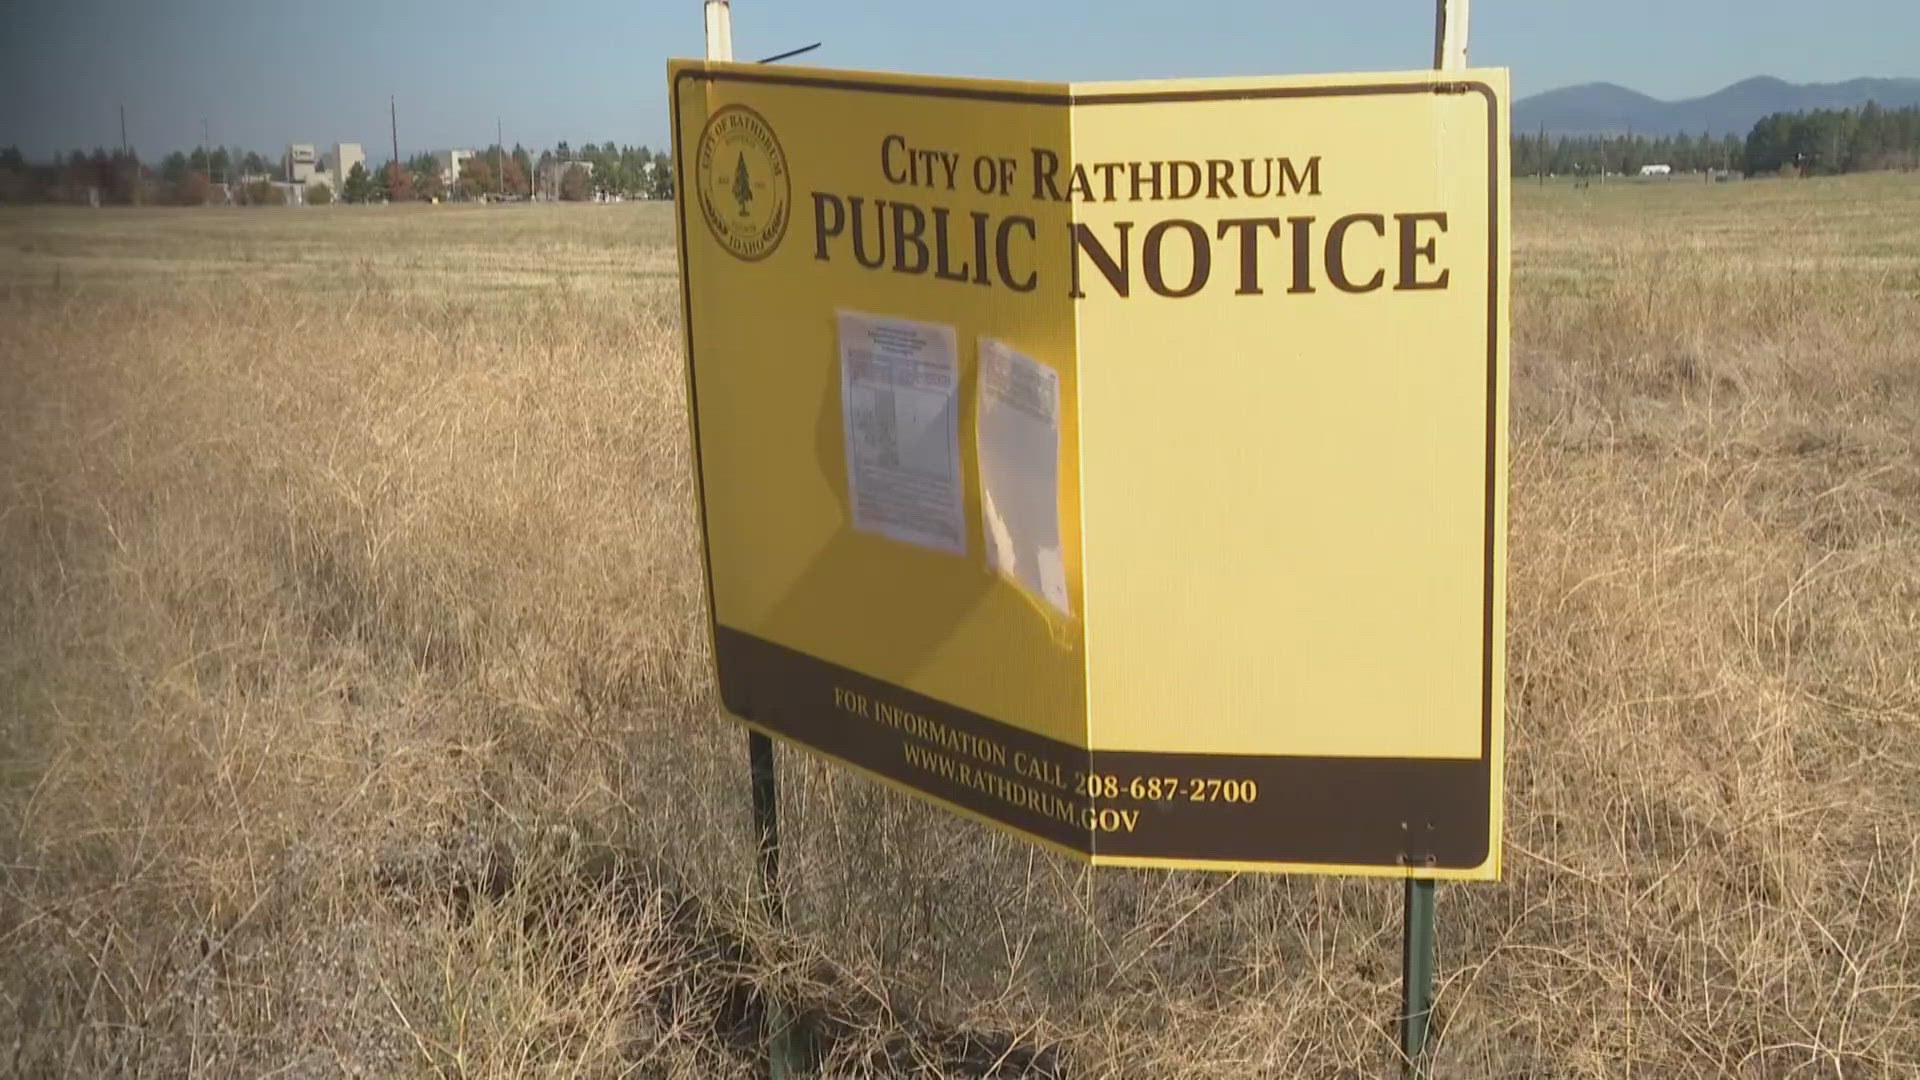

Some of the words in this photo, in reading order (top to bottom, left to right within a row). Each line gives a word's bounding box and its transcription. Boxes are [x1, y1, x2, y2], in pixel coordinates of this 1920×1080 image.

[714, 119, 728, 136] OF
[882, 134, 959, 191] CITY
[973, 153, 1017, 196] OF
[1031, 147, 1323, 203] RATHDRUM
[728, 235, 765, 254] IDAHO
[812, 190, 1038, 293] PUBLIC
[1070, 211, 1450, 299] NOTICE
[834, 687, 869, 717] FOR
[874, 702, 1007, 767] INFORMATION
[1014, 752, 1068, 791] CALL
[1074, 771, 1258, 803] 208-687-2700
[903, 742, 1140, 833] WWW.RATHDRUM.GOV
